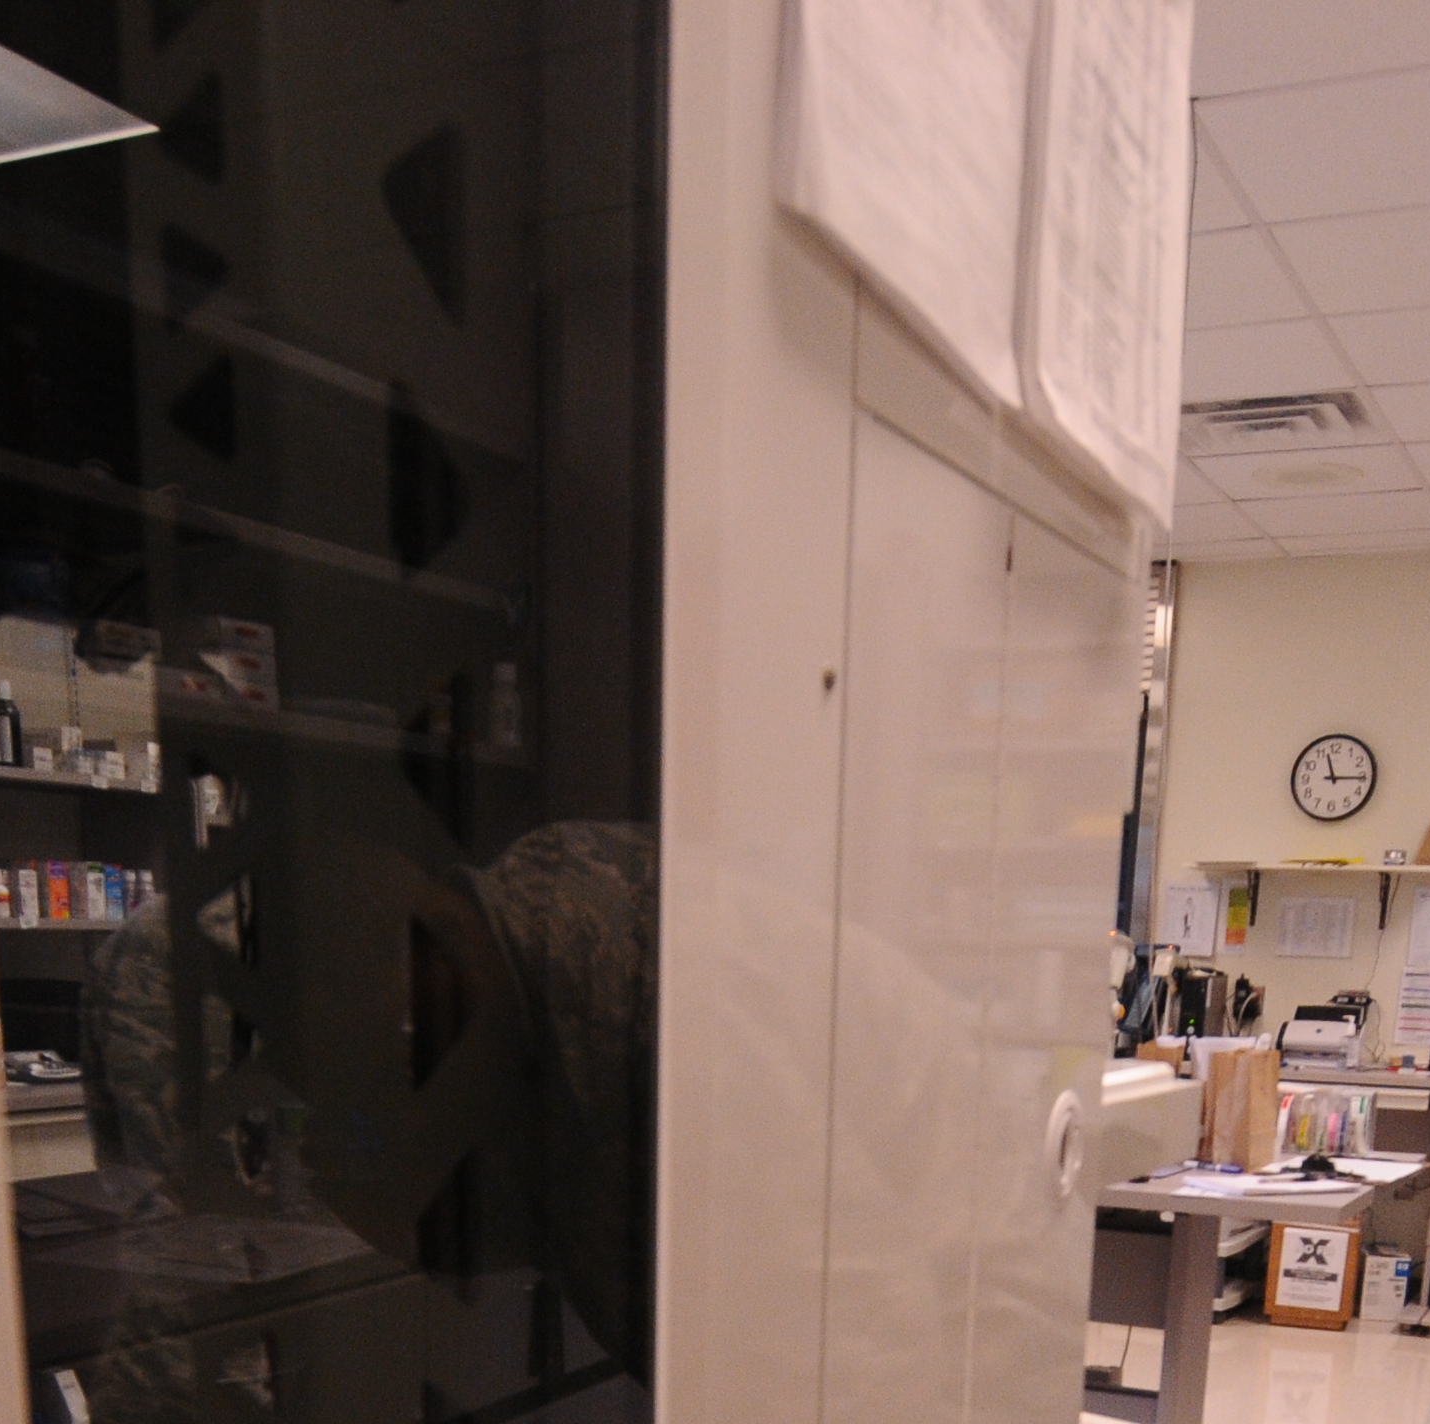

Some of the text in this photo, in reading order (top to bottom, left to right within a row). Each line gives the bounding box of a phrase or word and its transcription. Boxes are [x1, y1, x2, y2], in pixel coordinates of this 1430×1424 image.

[1316, 748, 1325, 759] 11
[1330, 742, 1342, 754] 12
[1348, 747, 1353, 758] 1
[1305, 760, 1317, 771] 10
[1355, 756, 1364, 768] 2
[1301, 773, 1310, 785] 9
[1304, 787, 1312, 798] 8
[1354, 785, 1362, 796] 4
[1315, 797, 1322, 809] 7
[1327, 800, 1336, 812] 6
[1343, 796, 1351, 808] 5
